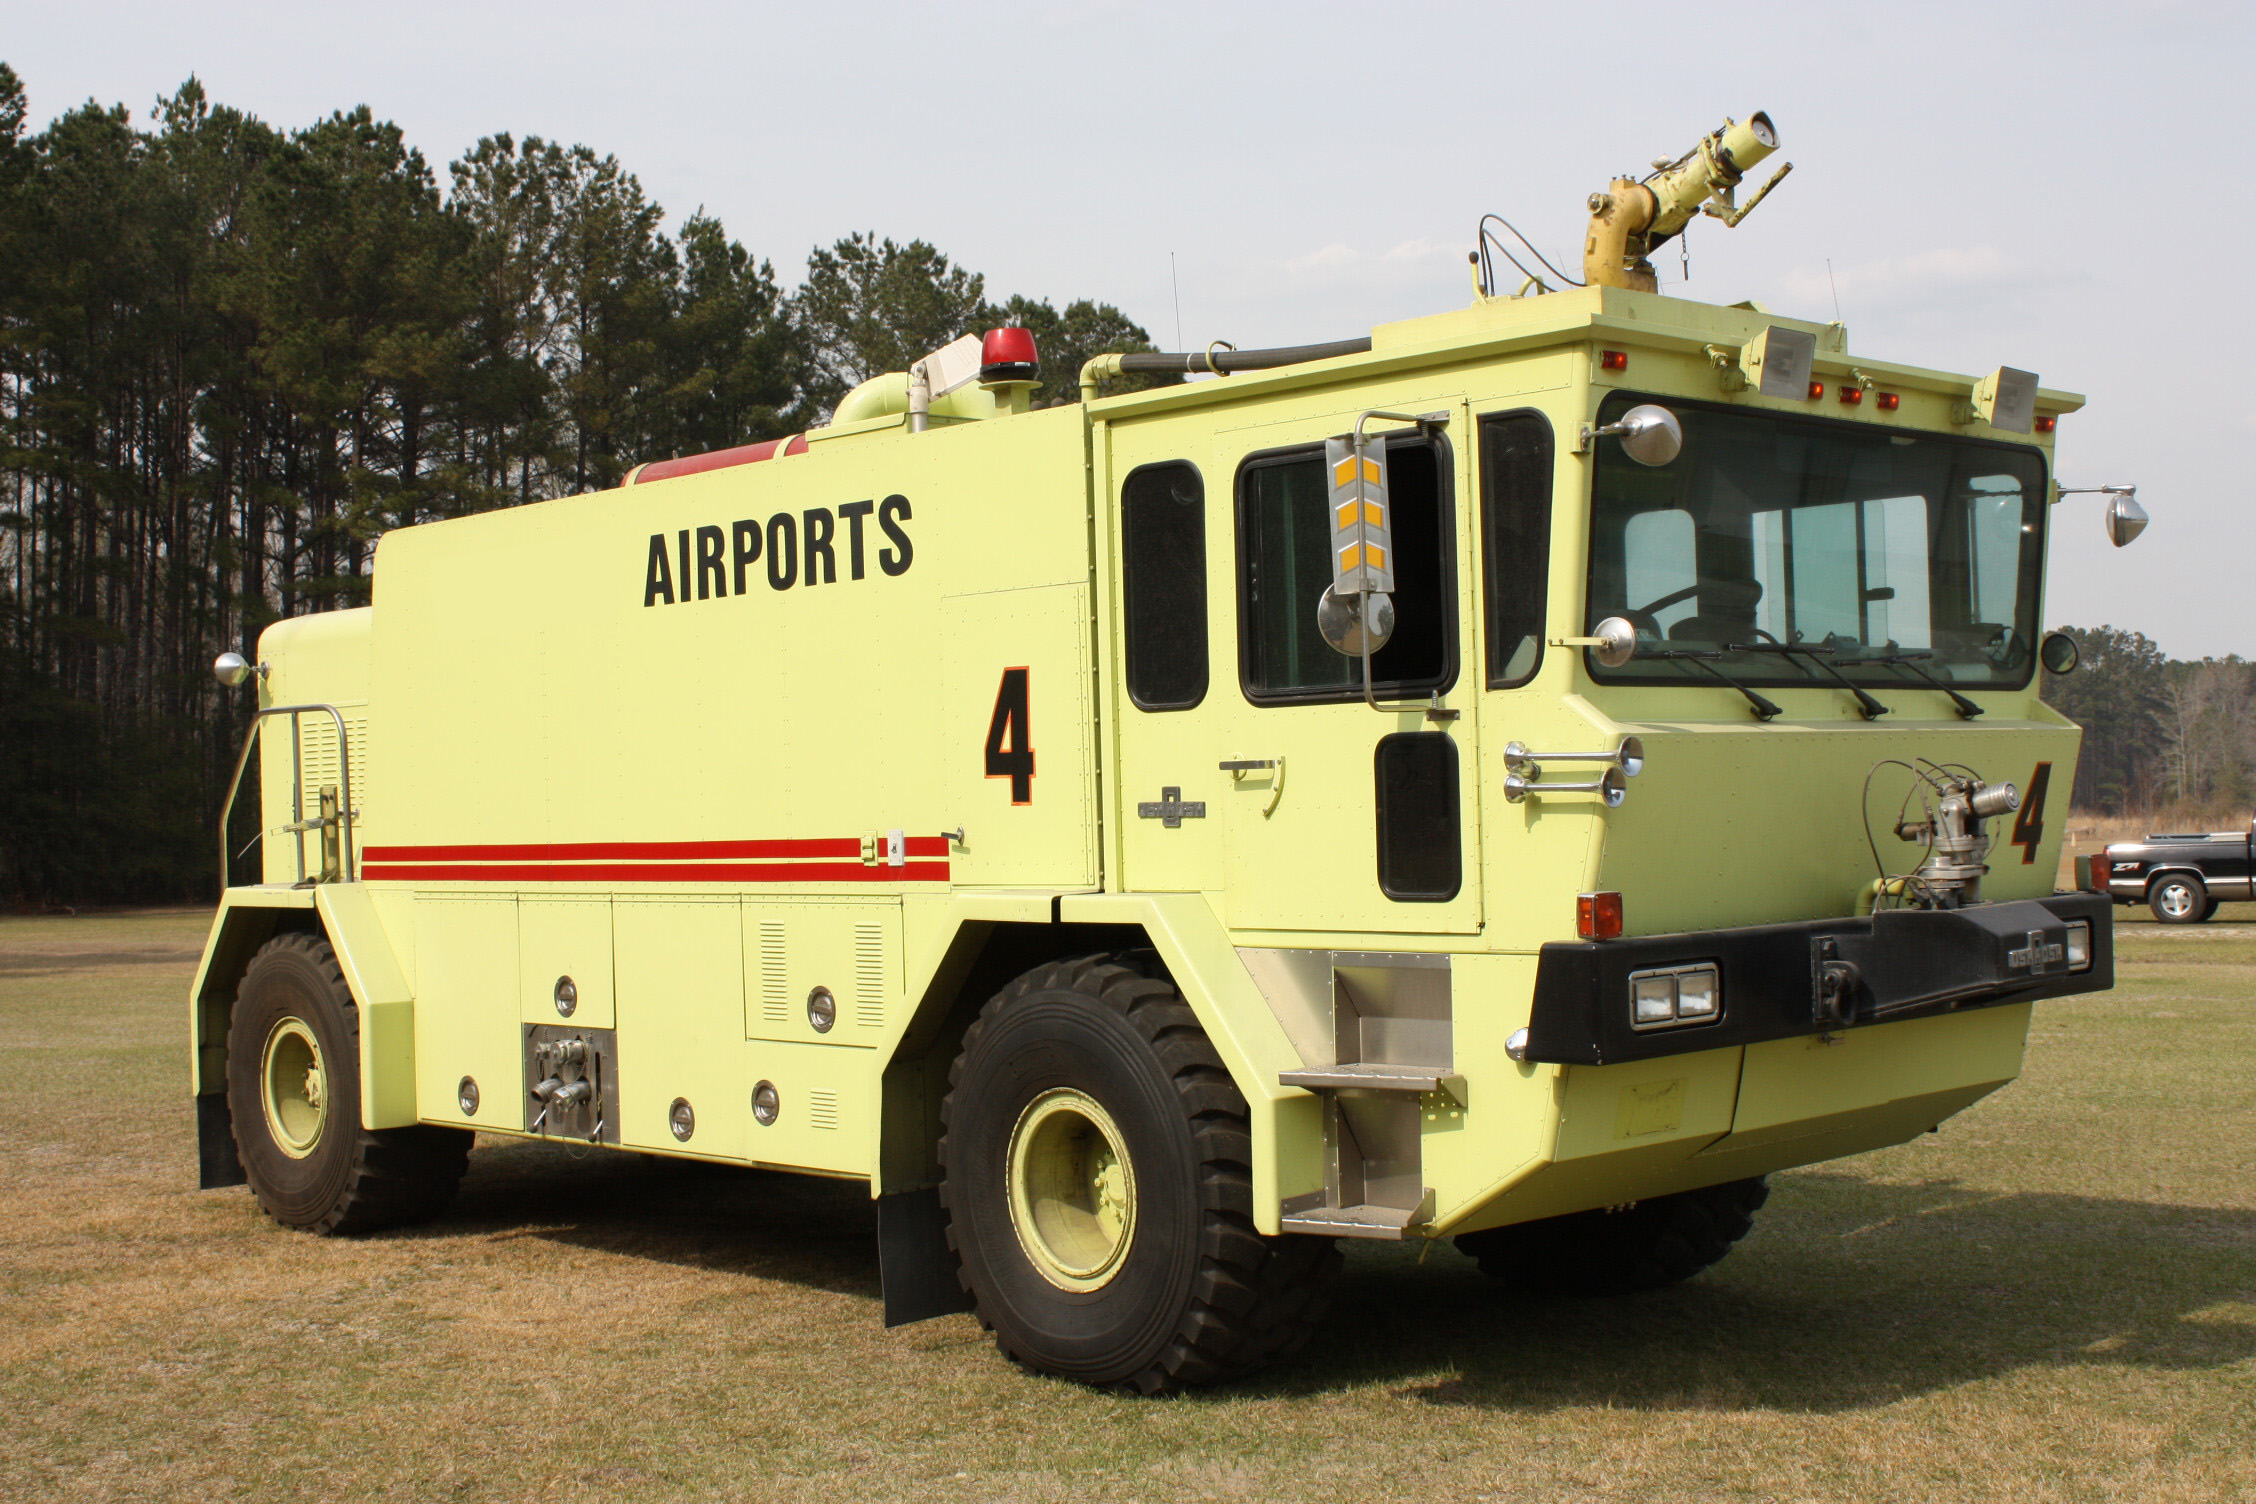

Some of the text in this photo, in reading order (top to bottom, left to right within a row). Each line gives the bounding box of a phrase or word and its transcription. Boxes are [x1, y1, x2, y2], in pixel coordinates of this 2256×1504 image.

[643, 494, 914, 608] AIRPORTS
[984, 665, 1036, 806] 4
[2010, 761, 2052, 865] 4
